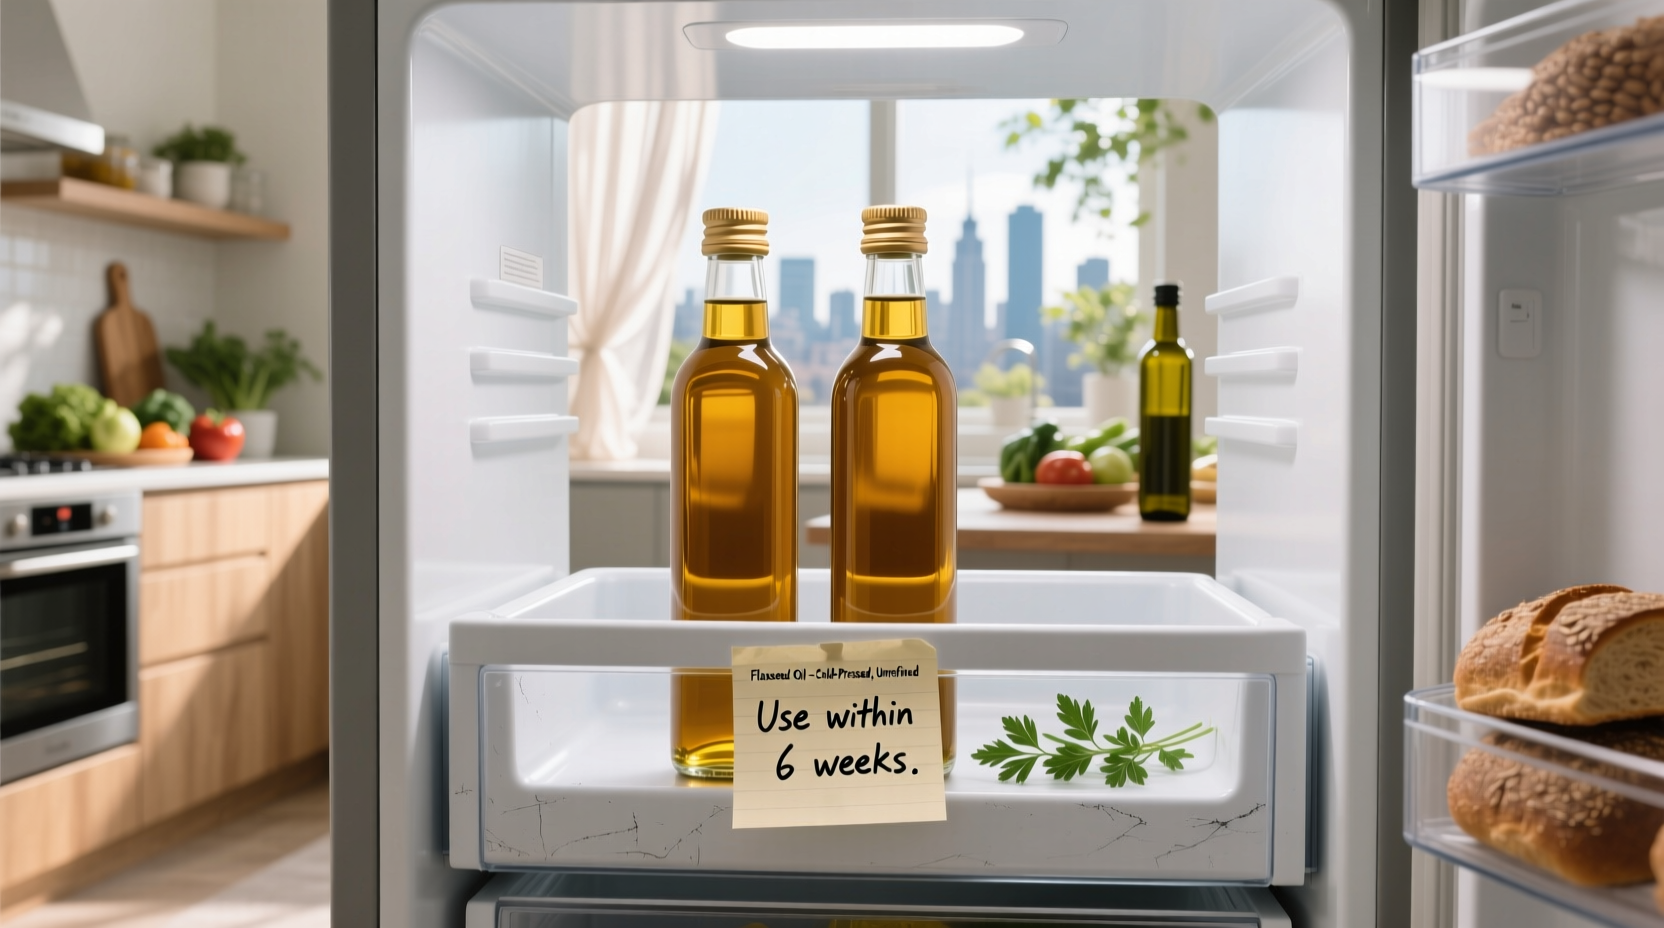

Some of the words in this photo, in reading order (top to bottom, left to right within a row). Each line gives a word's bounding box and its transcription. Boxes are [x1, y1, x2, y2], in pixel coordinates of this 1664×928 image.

[757, 699, 811, 733] Use
[826, 695, 914, 730] within
[775, 743, 796, 781] 6
[813, 741, 919, 778] weeks.
